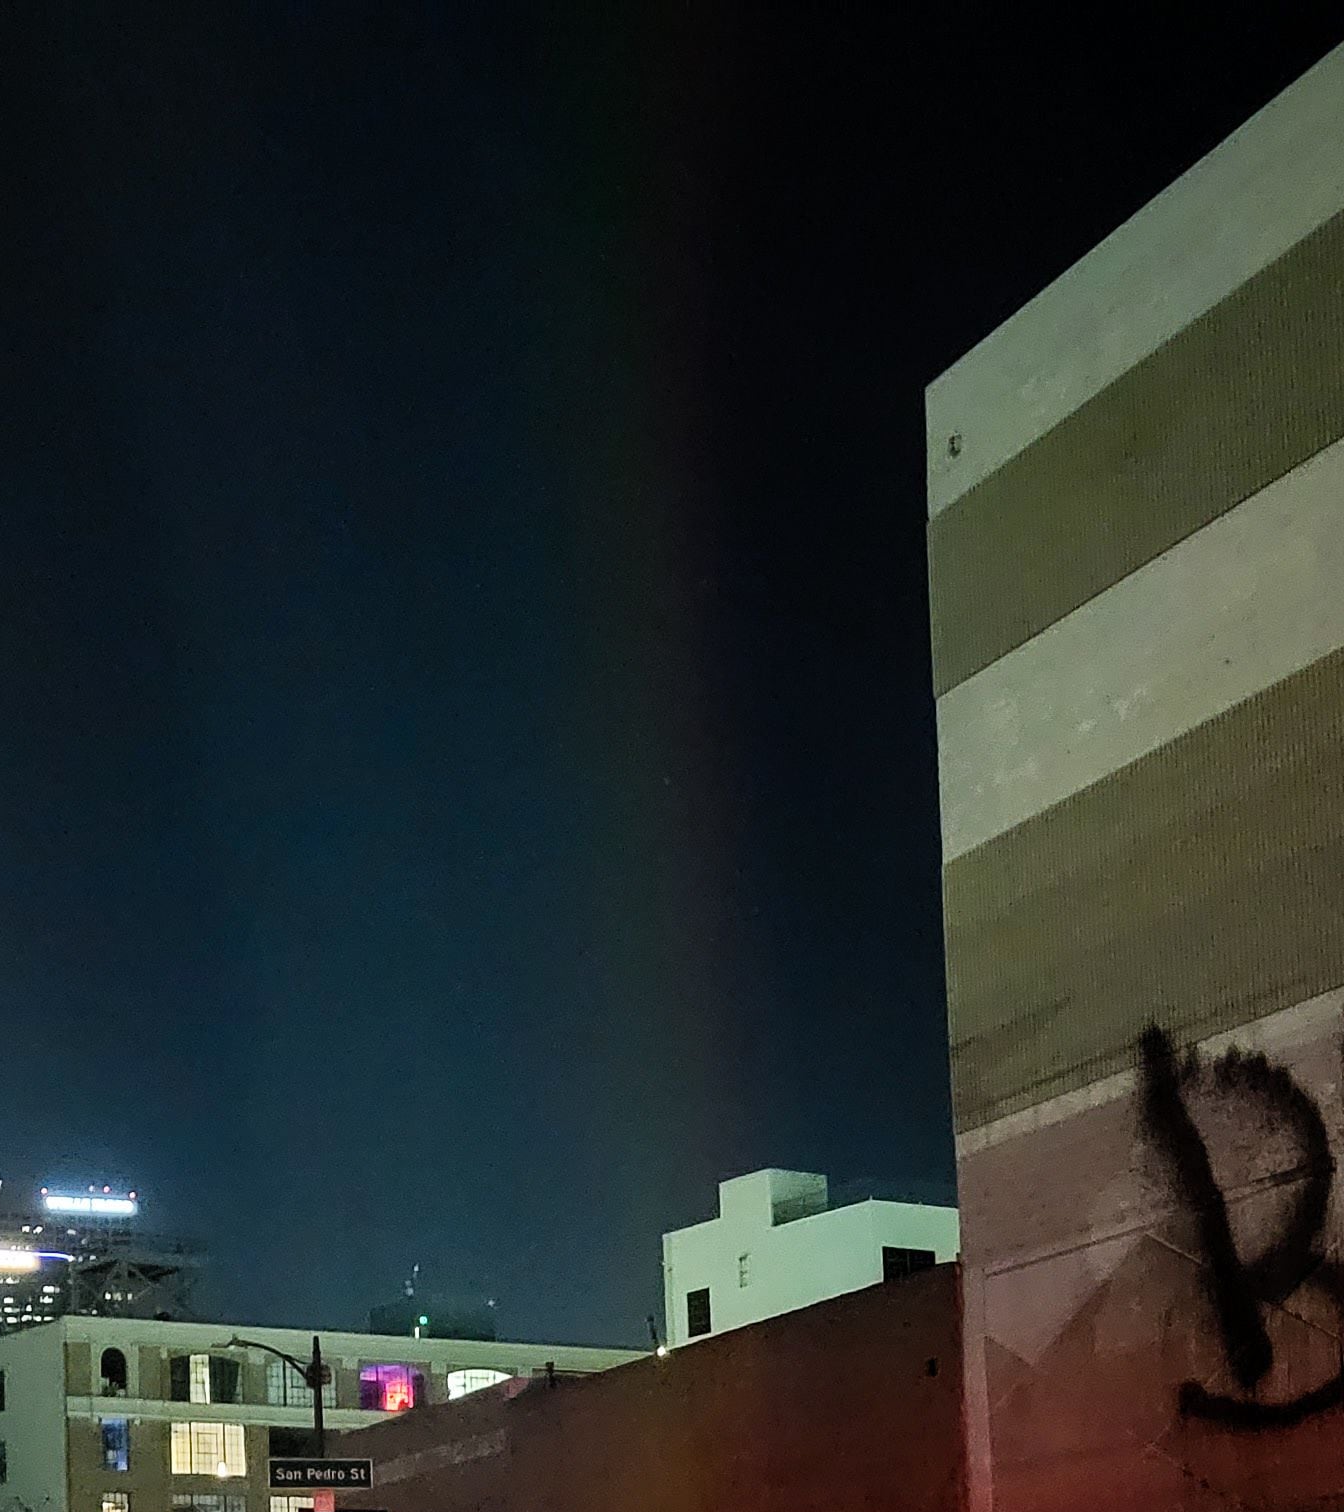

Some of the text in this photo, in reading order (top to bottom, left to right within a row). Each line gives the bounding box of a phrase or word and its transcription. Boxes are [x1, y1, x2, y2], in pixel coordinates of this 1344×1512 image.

[276, 1468, 366, 1480] San Pedro St
